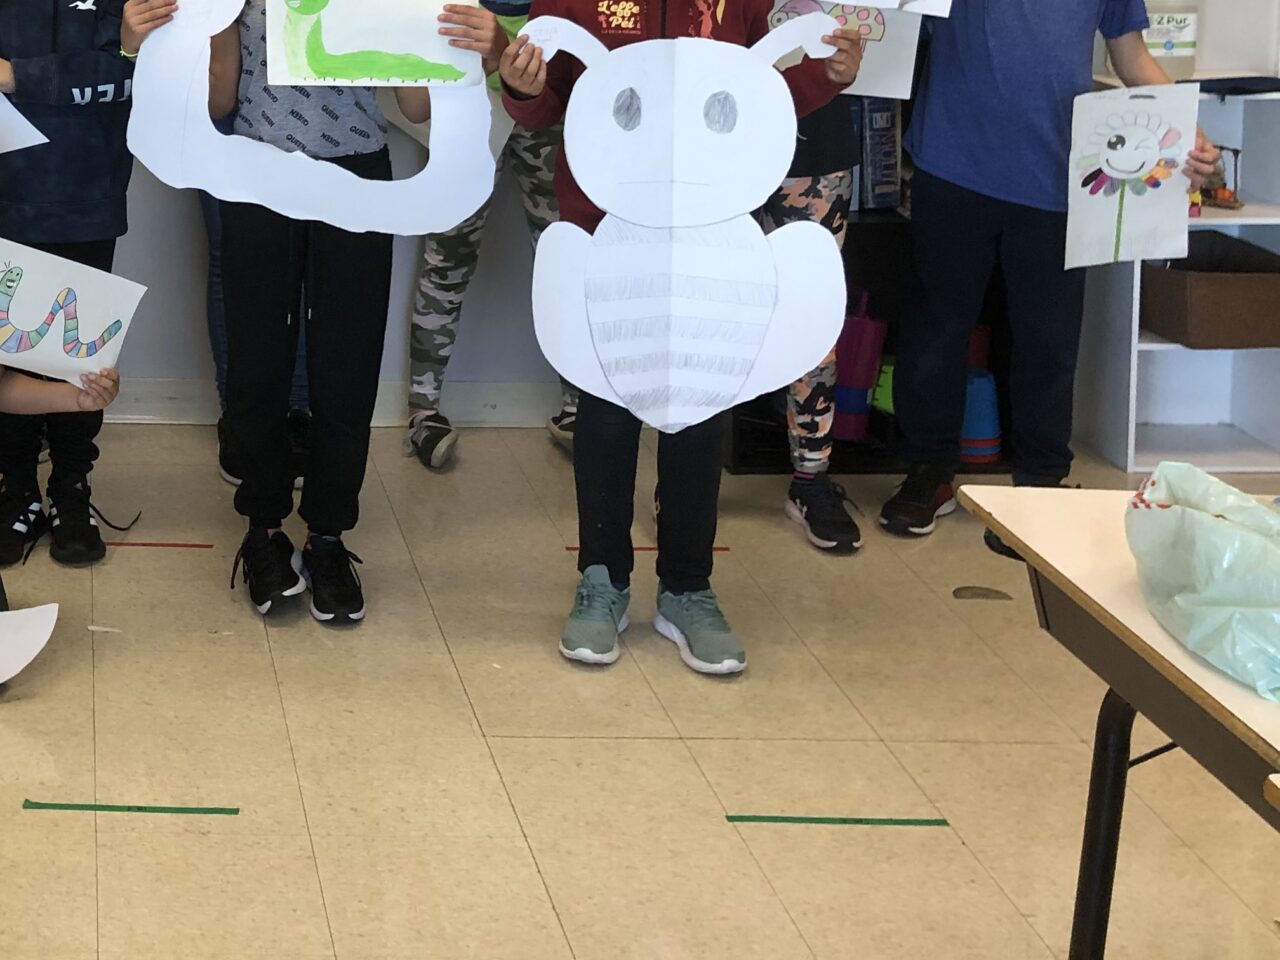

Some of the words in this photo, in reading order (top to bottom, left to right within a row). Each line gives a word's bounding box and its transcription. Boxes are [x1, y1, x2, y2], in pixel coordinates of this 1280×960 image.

[609, 15, 634, 28] Péi
[289, 108, 309, 127] QUEEN
[321, 104, 340, 122] QUEEN
[320, 132, 341, 148] QUEEN
[350, 125, 370, 140] QUEEN
[286, 133, 307, 151] QUEEN
